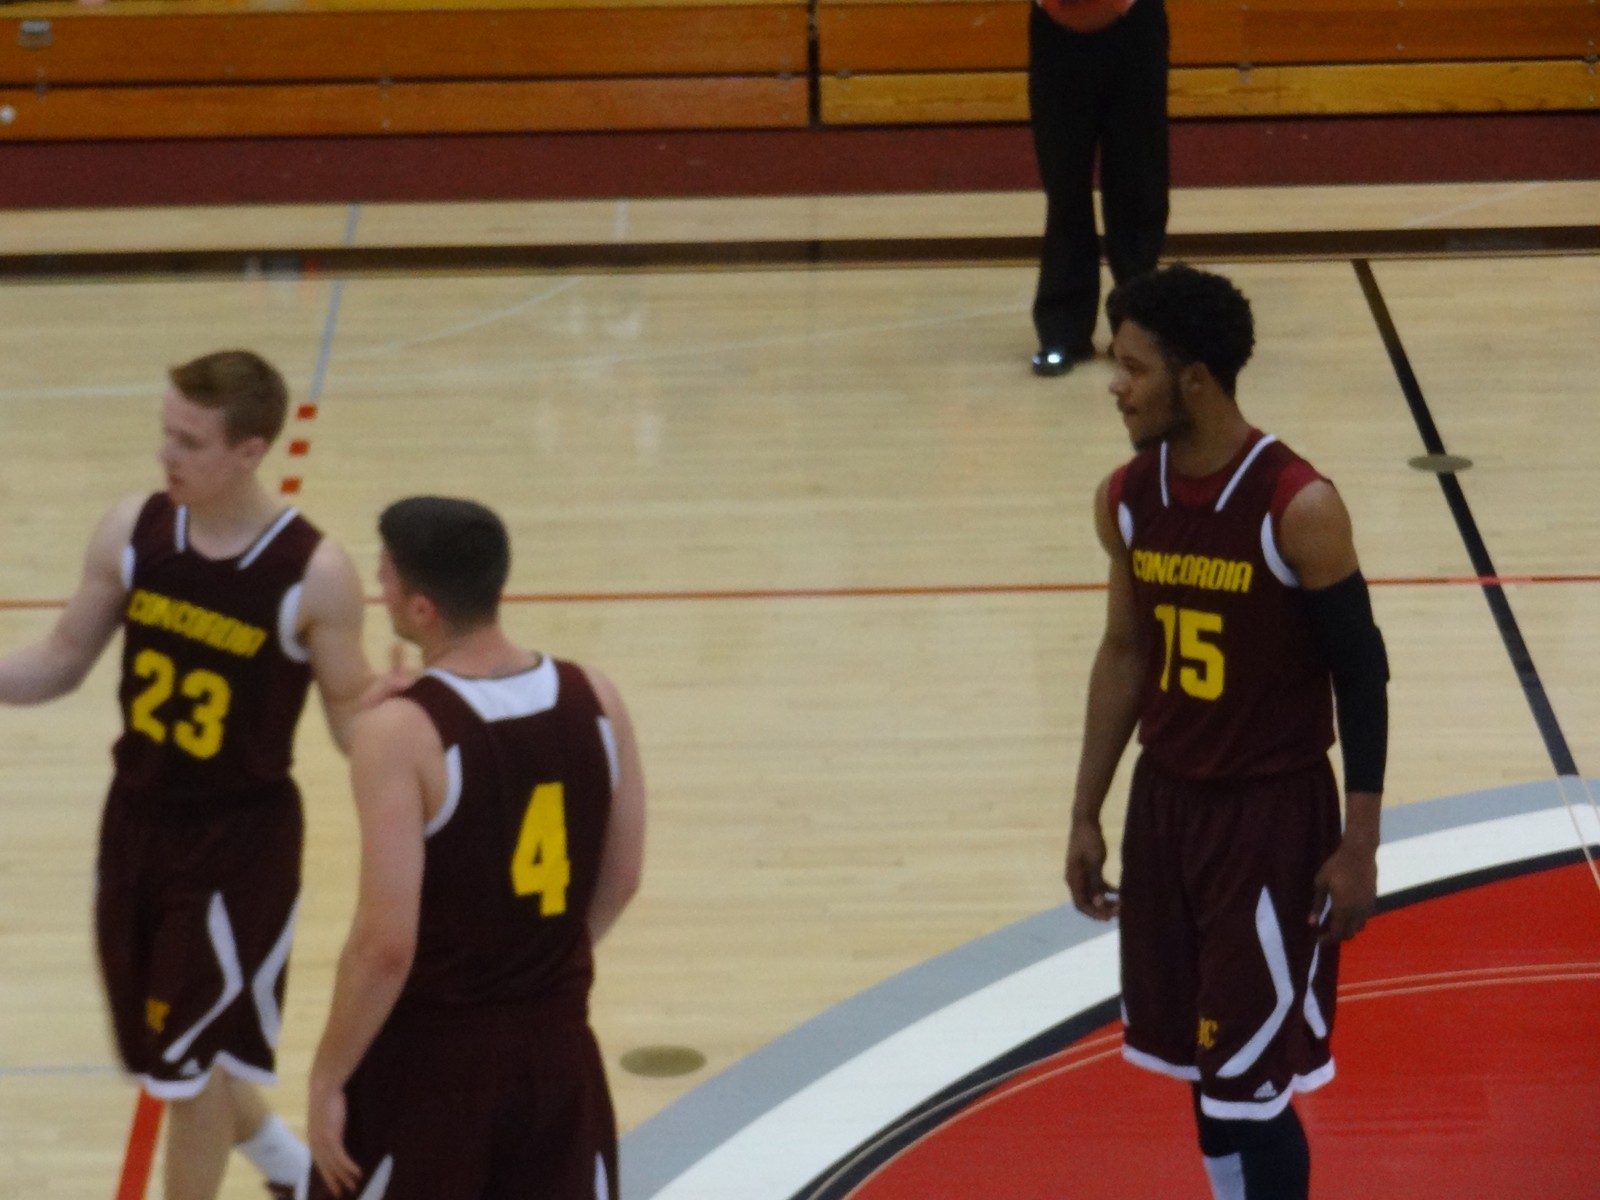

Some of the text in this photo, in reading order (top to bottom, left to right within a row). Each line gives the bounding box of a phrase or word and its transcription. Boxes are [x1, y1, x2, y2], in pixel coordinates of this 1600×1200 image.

[1132, 548, 1253, 593] CONCORDIA
[131, 648, 231, 759] 23
[1153, 604, 1226, 701] 15
[510, 782, 571, 917] 4
